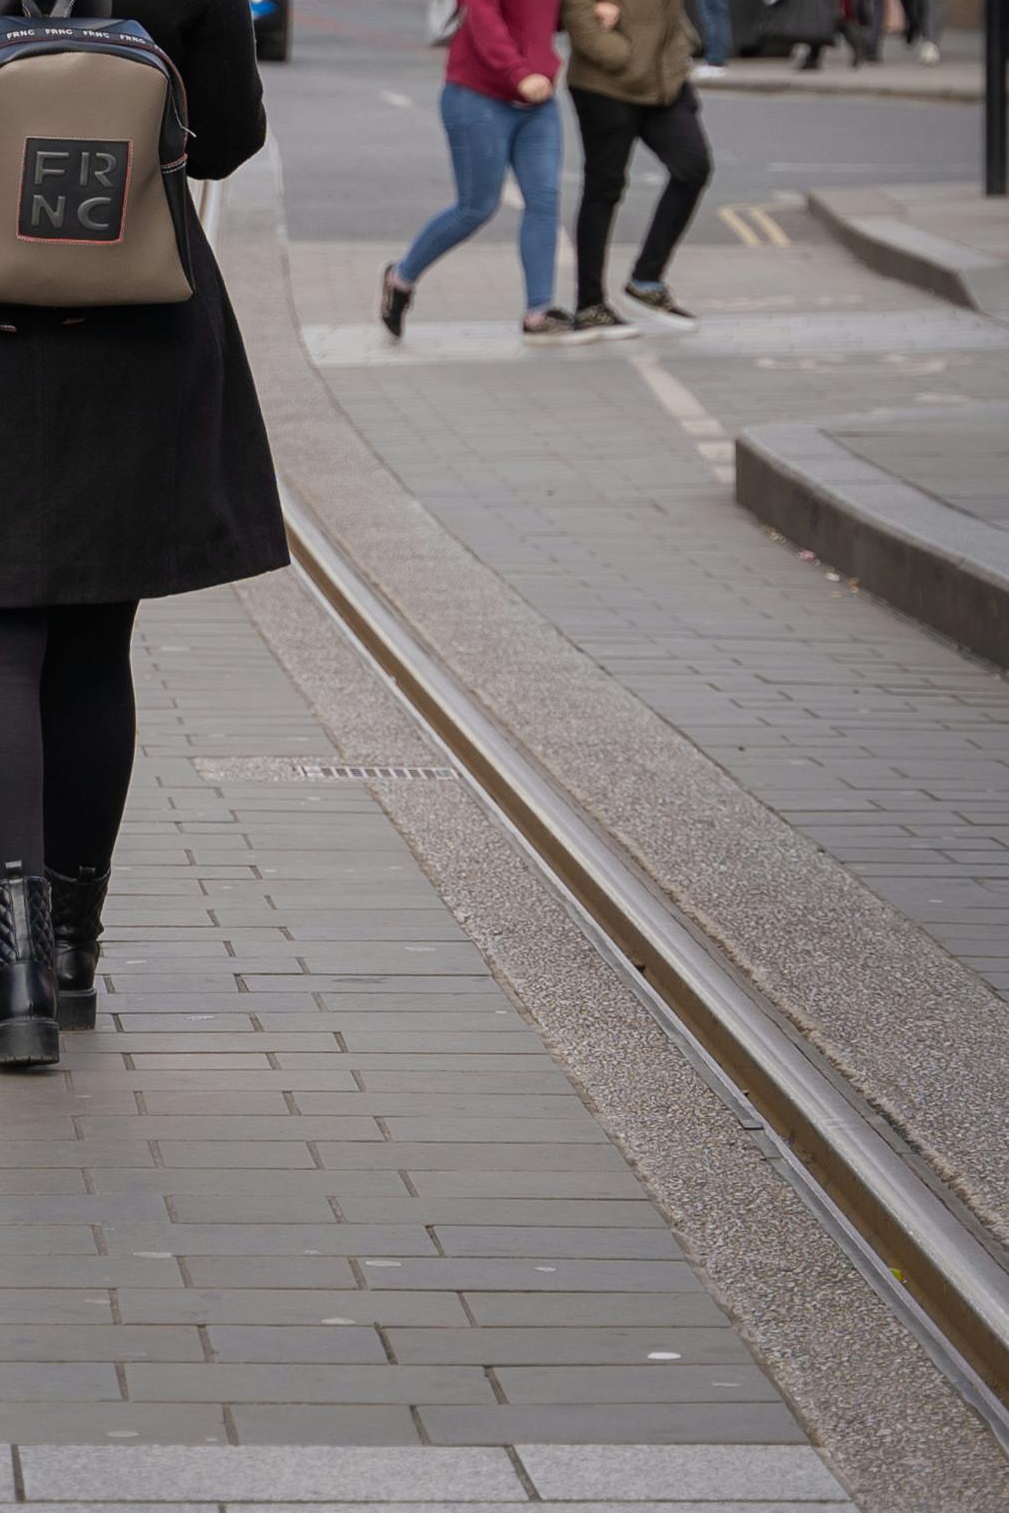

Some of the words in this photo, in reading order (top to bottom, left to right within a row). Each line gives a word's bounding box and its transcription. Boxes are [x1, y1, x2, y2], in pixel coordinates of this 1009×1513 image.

[6, 29, 36, 39] FRNC
[44, 27, 73, 36] FRNC
[82, 29, 111, 39] FRNC
[118, 33, 146, 45] FRNC
[34, 151, 117, 187] FR
[31, 194, 112, 230] NC
